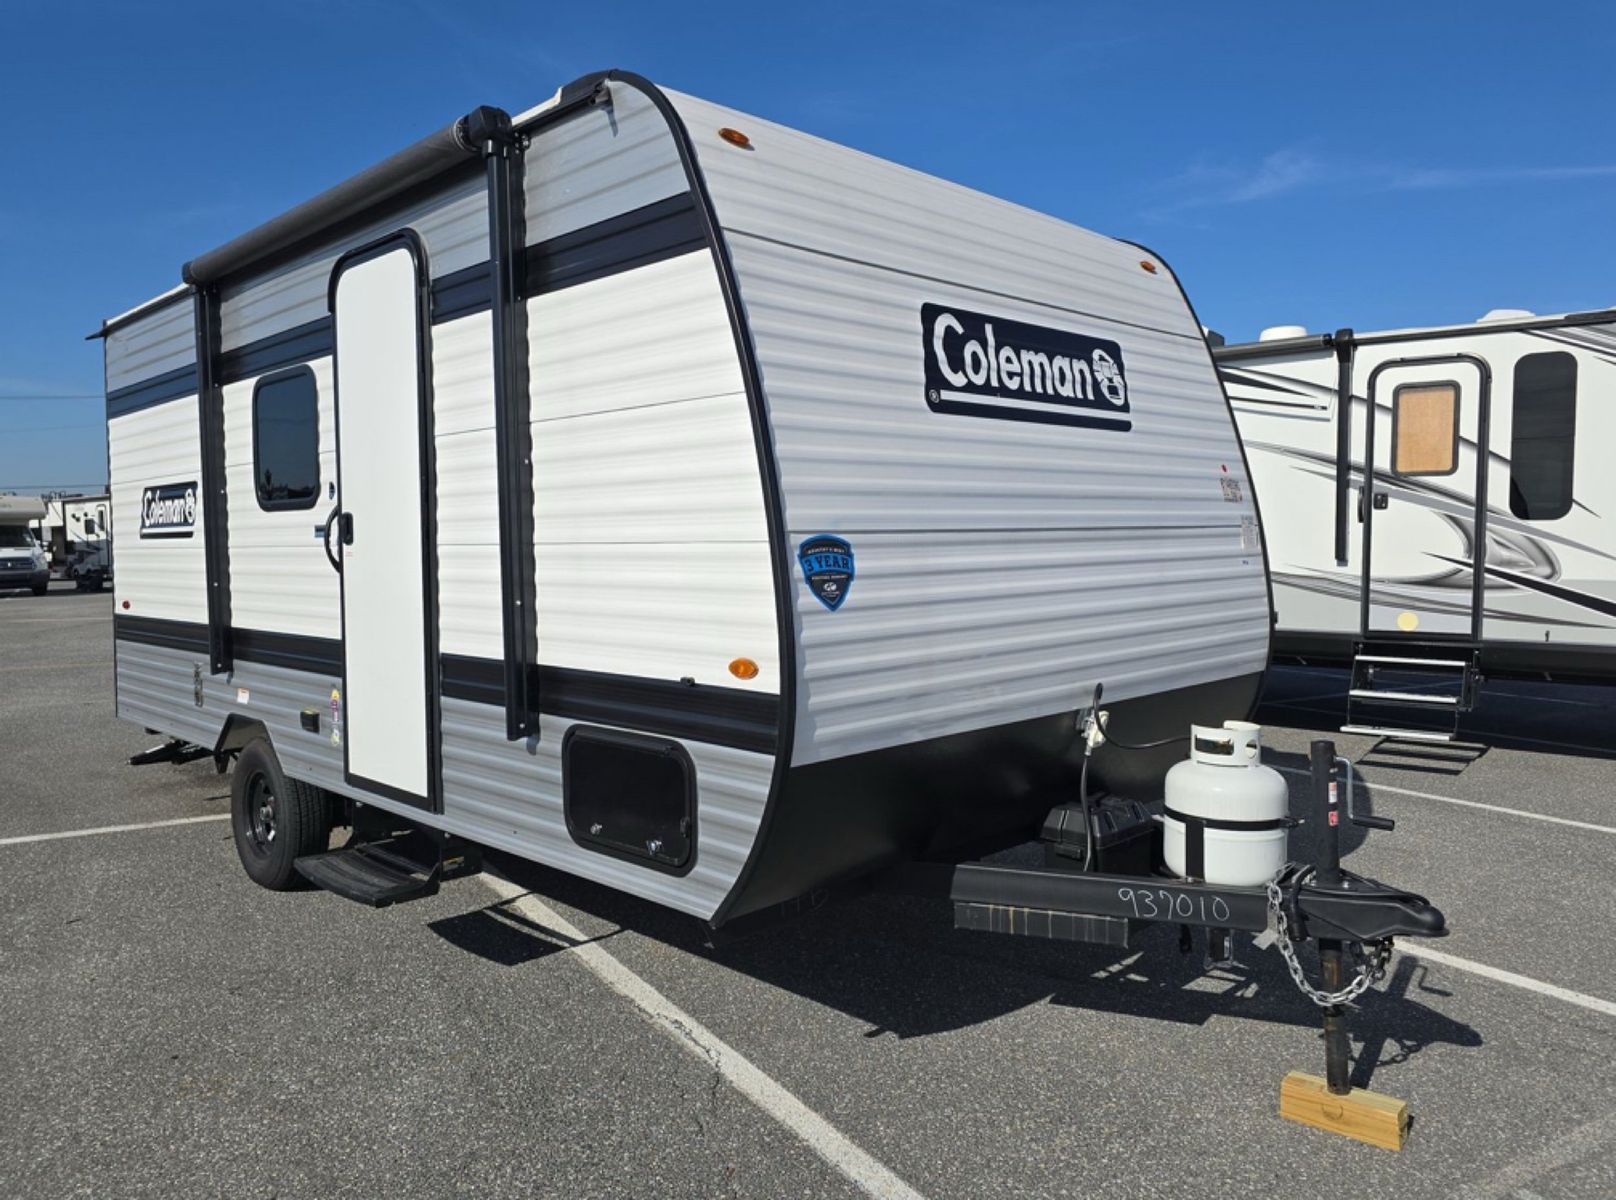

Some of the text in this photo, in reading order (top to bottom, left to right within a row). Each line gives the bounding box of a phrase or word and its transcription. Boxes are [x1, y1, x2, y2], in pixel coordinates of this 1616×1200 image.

[933, 313, 1094, 400] Coleman
[143, 489, 185, 527] Coleman
[816, 555, 850, 570] YEAR
[1118, 887, 1230, 922] 937010
